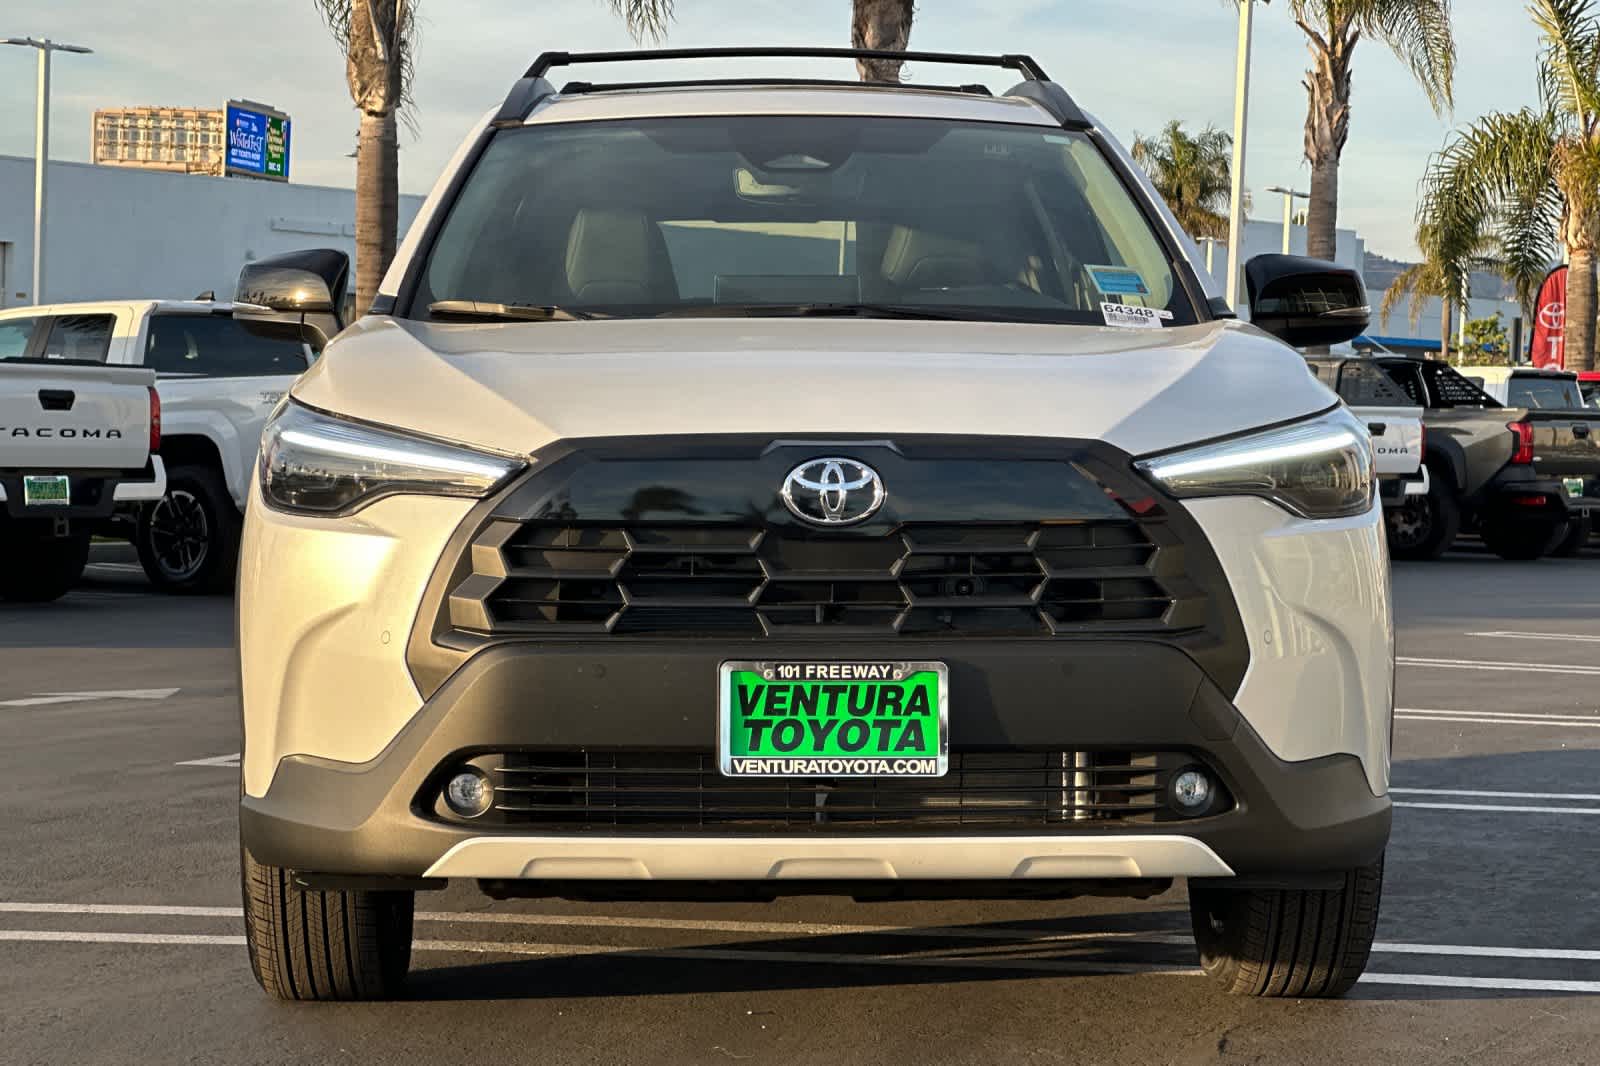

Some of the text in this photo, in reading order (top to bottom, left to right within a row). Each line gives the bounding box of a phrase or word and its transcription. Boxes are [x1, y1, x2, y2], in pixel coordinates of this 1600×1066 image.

[1103, 304, 1154, 318] 64348
[777, 665, 890, 679] 101 FREEWAY
[737, 684, 931, 716] VENTURA
[743, 718, 926, 752] TOYOTA
[733, 759, 936, 774] VENTURATOYOTA.COM
